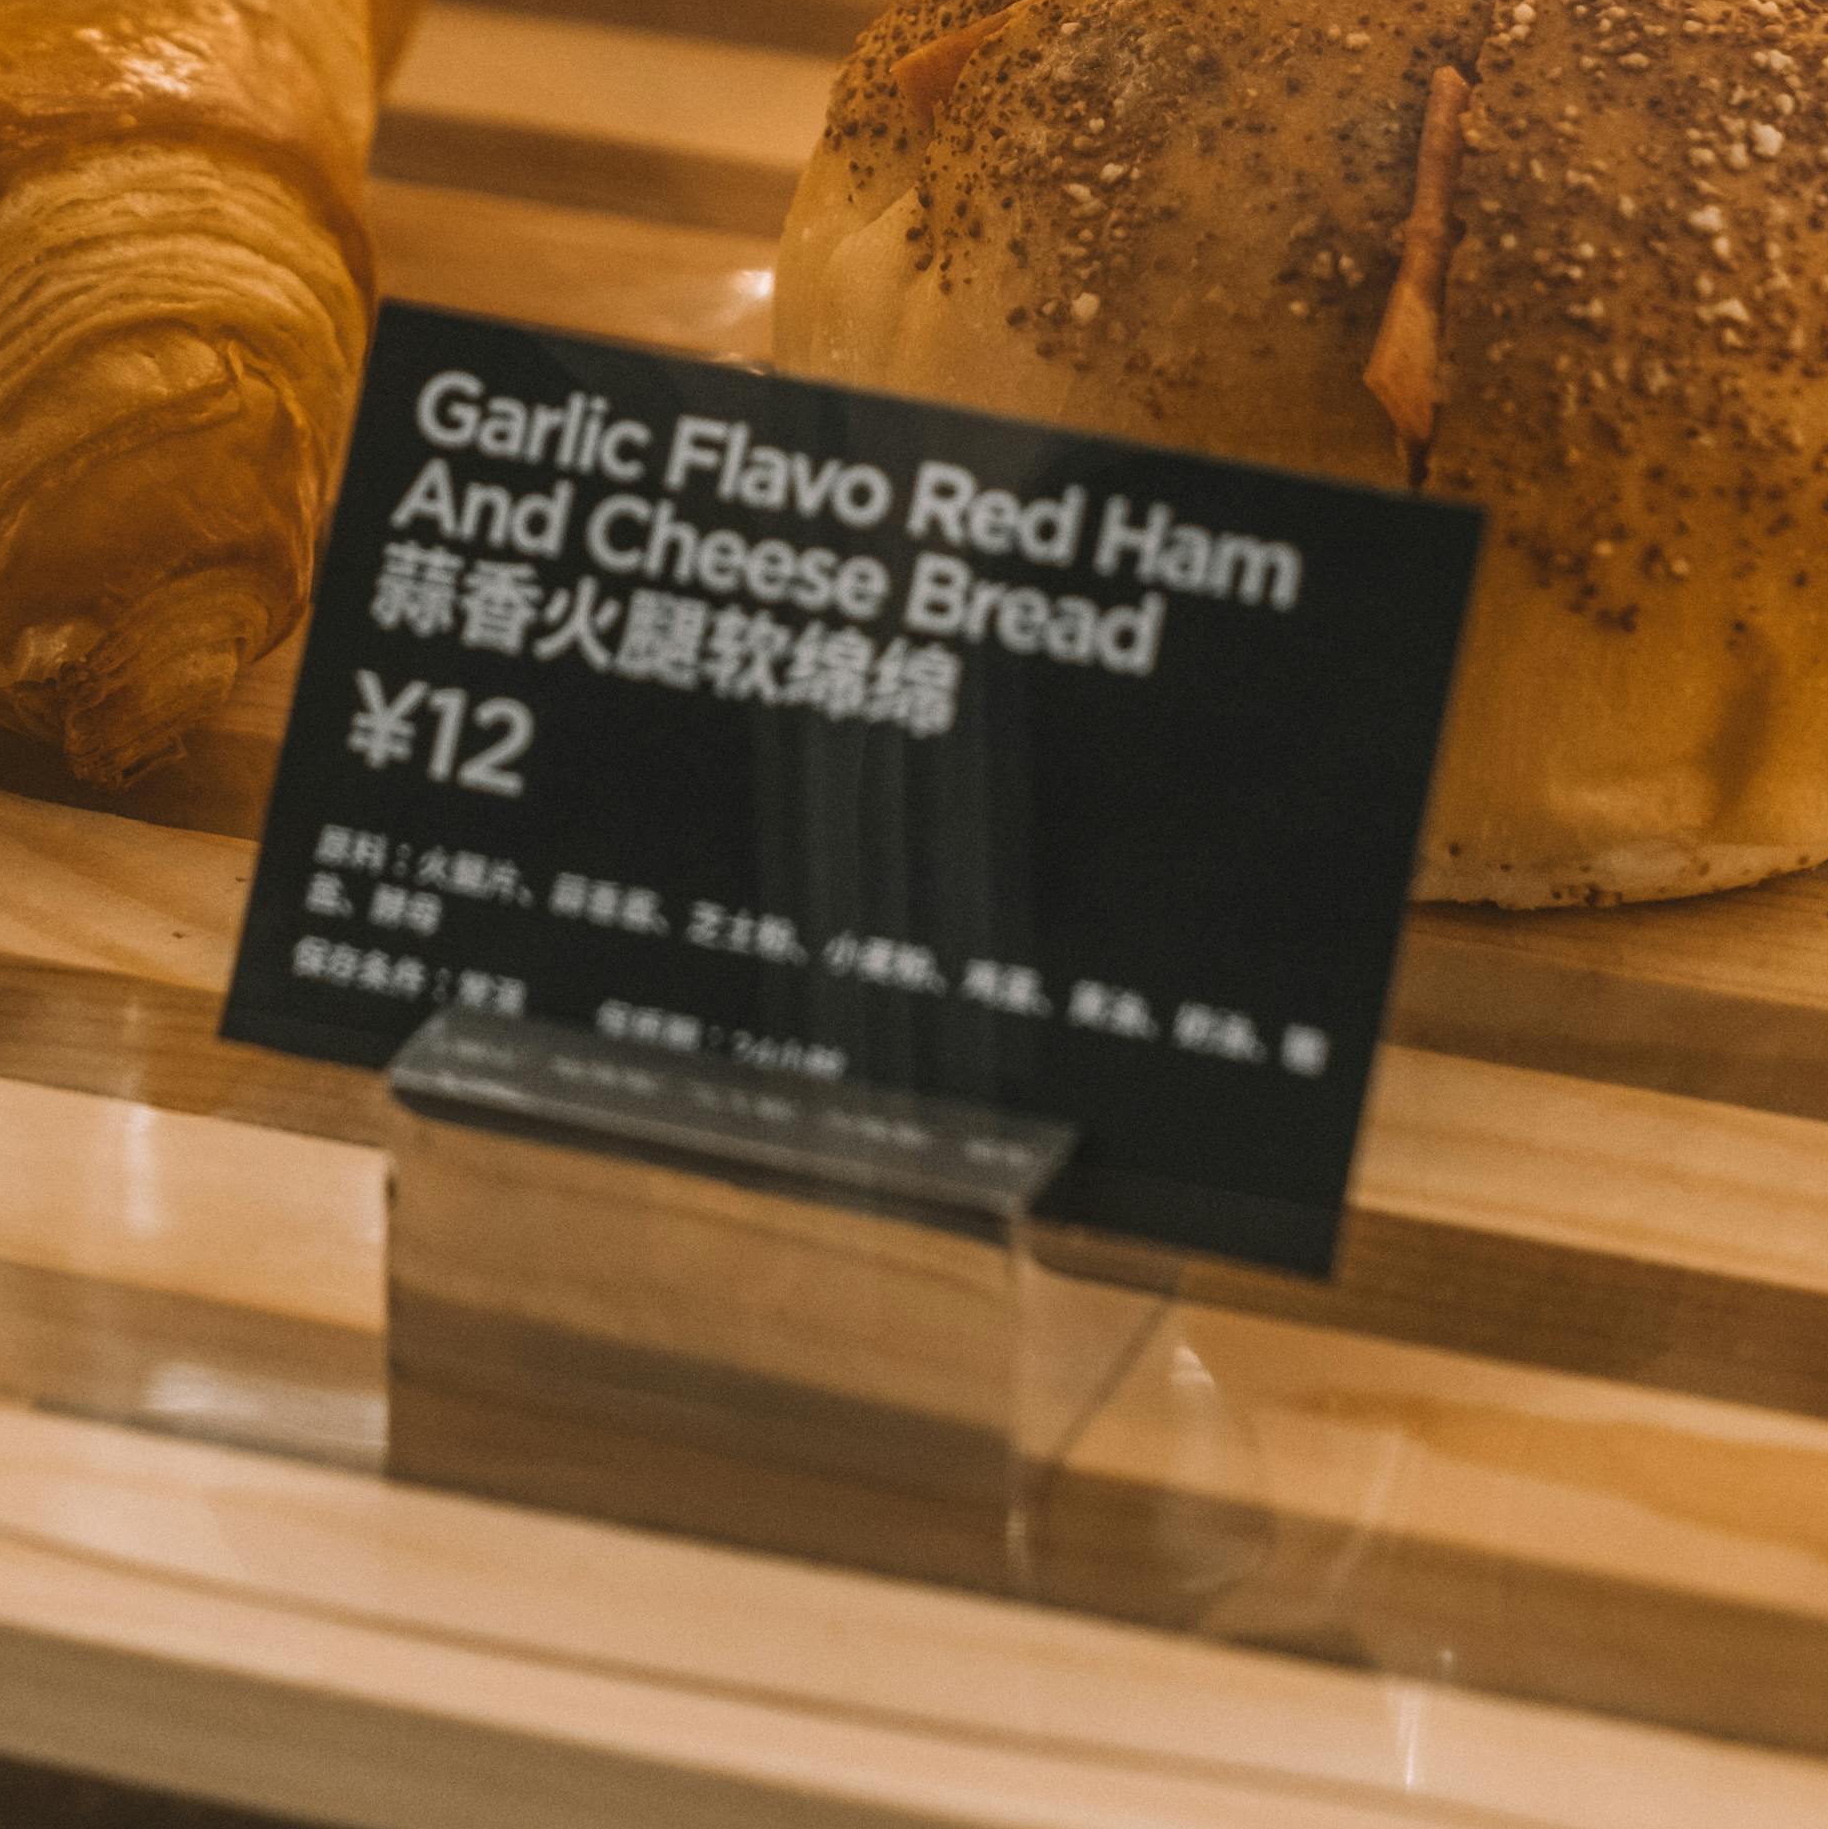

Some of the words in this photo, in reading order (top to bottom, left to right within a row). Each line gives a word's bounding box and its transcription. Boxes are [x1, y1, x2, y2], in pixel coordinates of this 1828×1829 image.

[392, 459, 573, 556] And
[588, 495, 887, 619] Cheese
[905, 552, 1163, 673] Bread
[418, 372, 650, 480] Garlic
[666, 416, 892, 526] Flavo
[907, 461, 1083, 561] Red
[1095, 497, 1300, 608] Ham
[349, 670, 533, 795] ¥12
[372, 541, 960, 736] 蒜香火腿软绵绵
